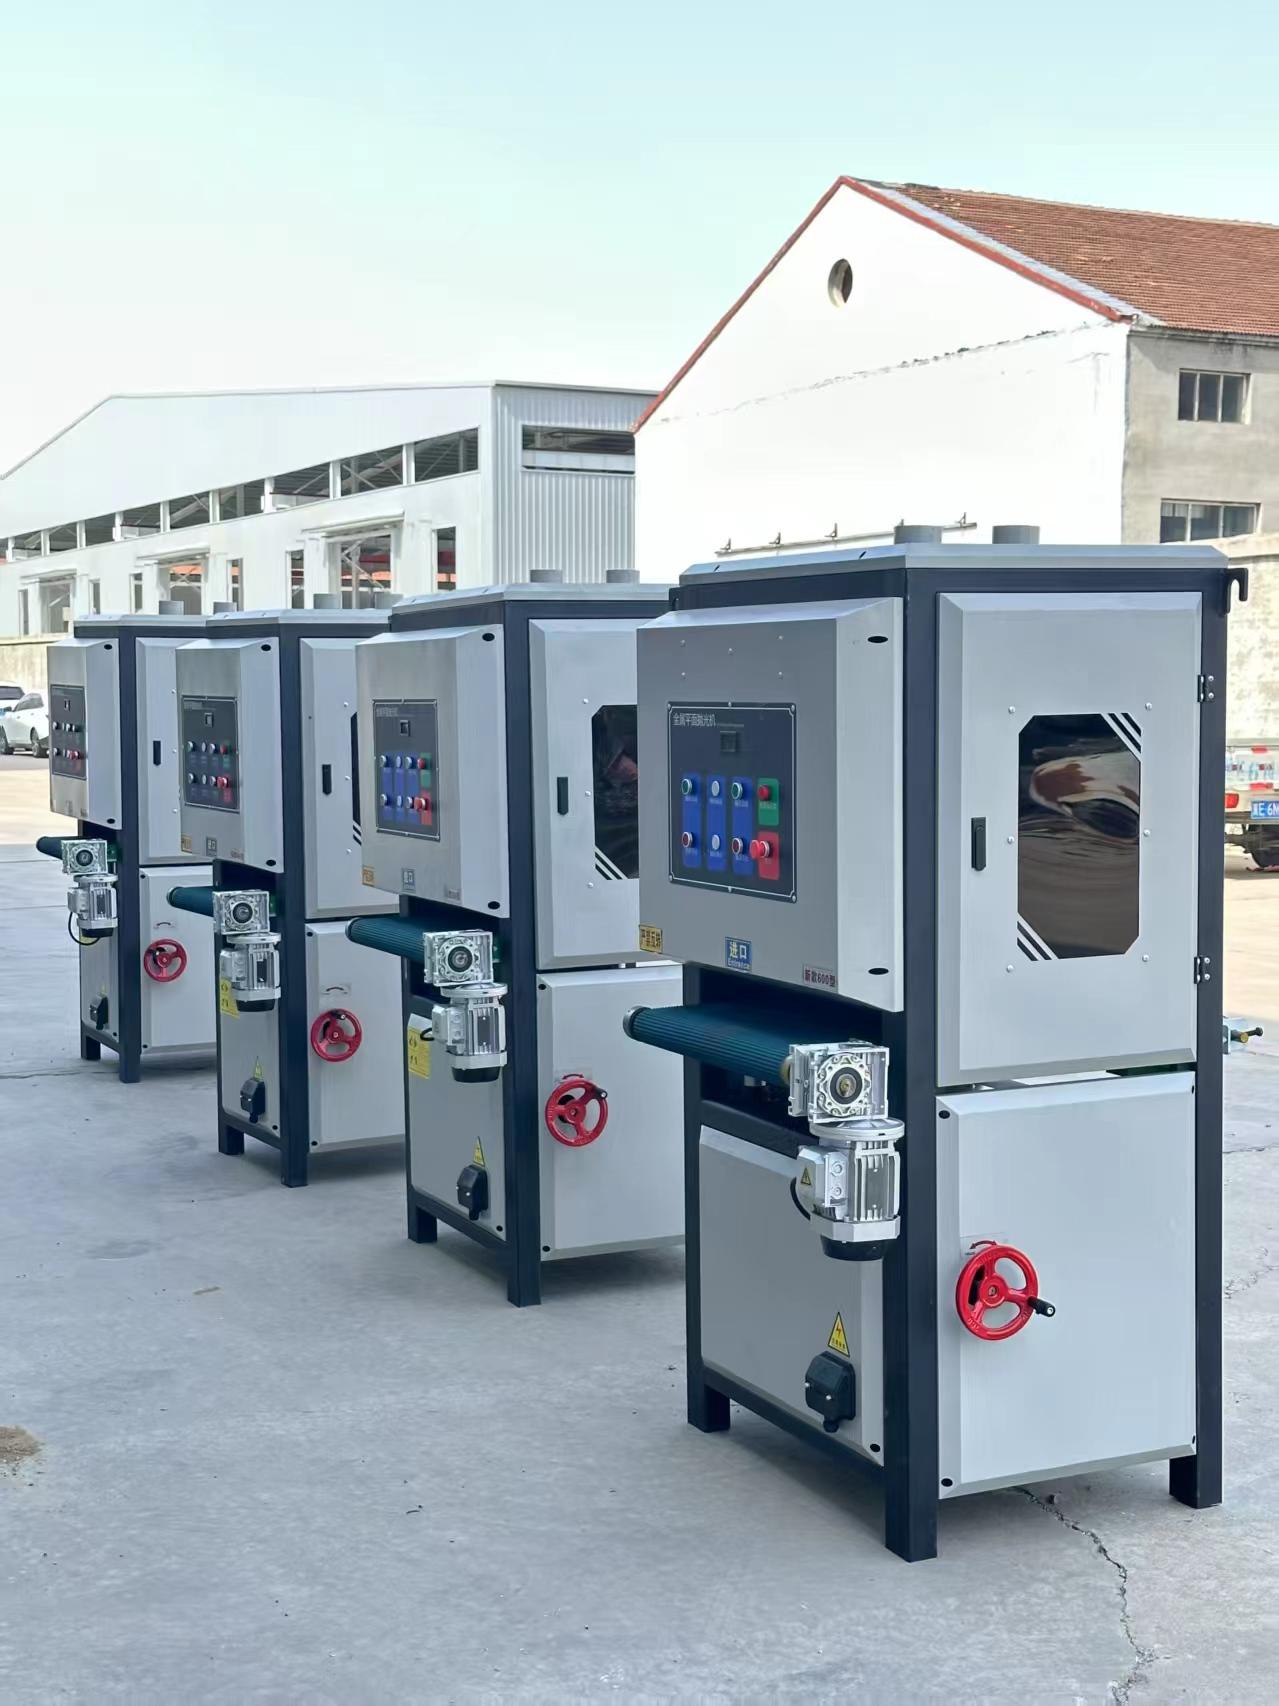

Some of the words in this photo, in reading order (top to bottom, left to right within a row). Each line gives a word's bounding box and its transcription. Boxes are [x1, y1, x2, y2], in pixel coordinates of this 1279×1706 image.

[672, 712, 717, 727] 金属平面抛光机
[729, 941, 747, 959] 进口
